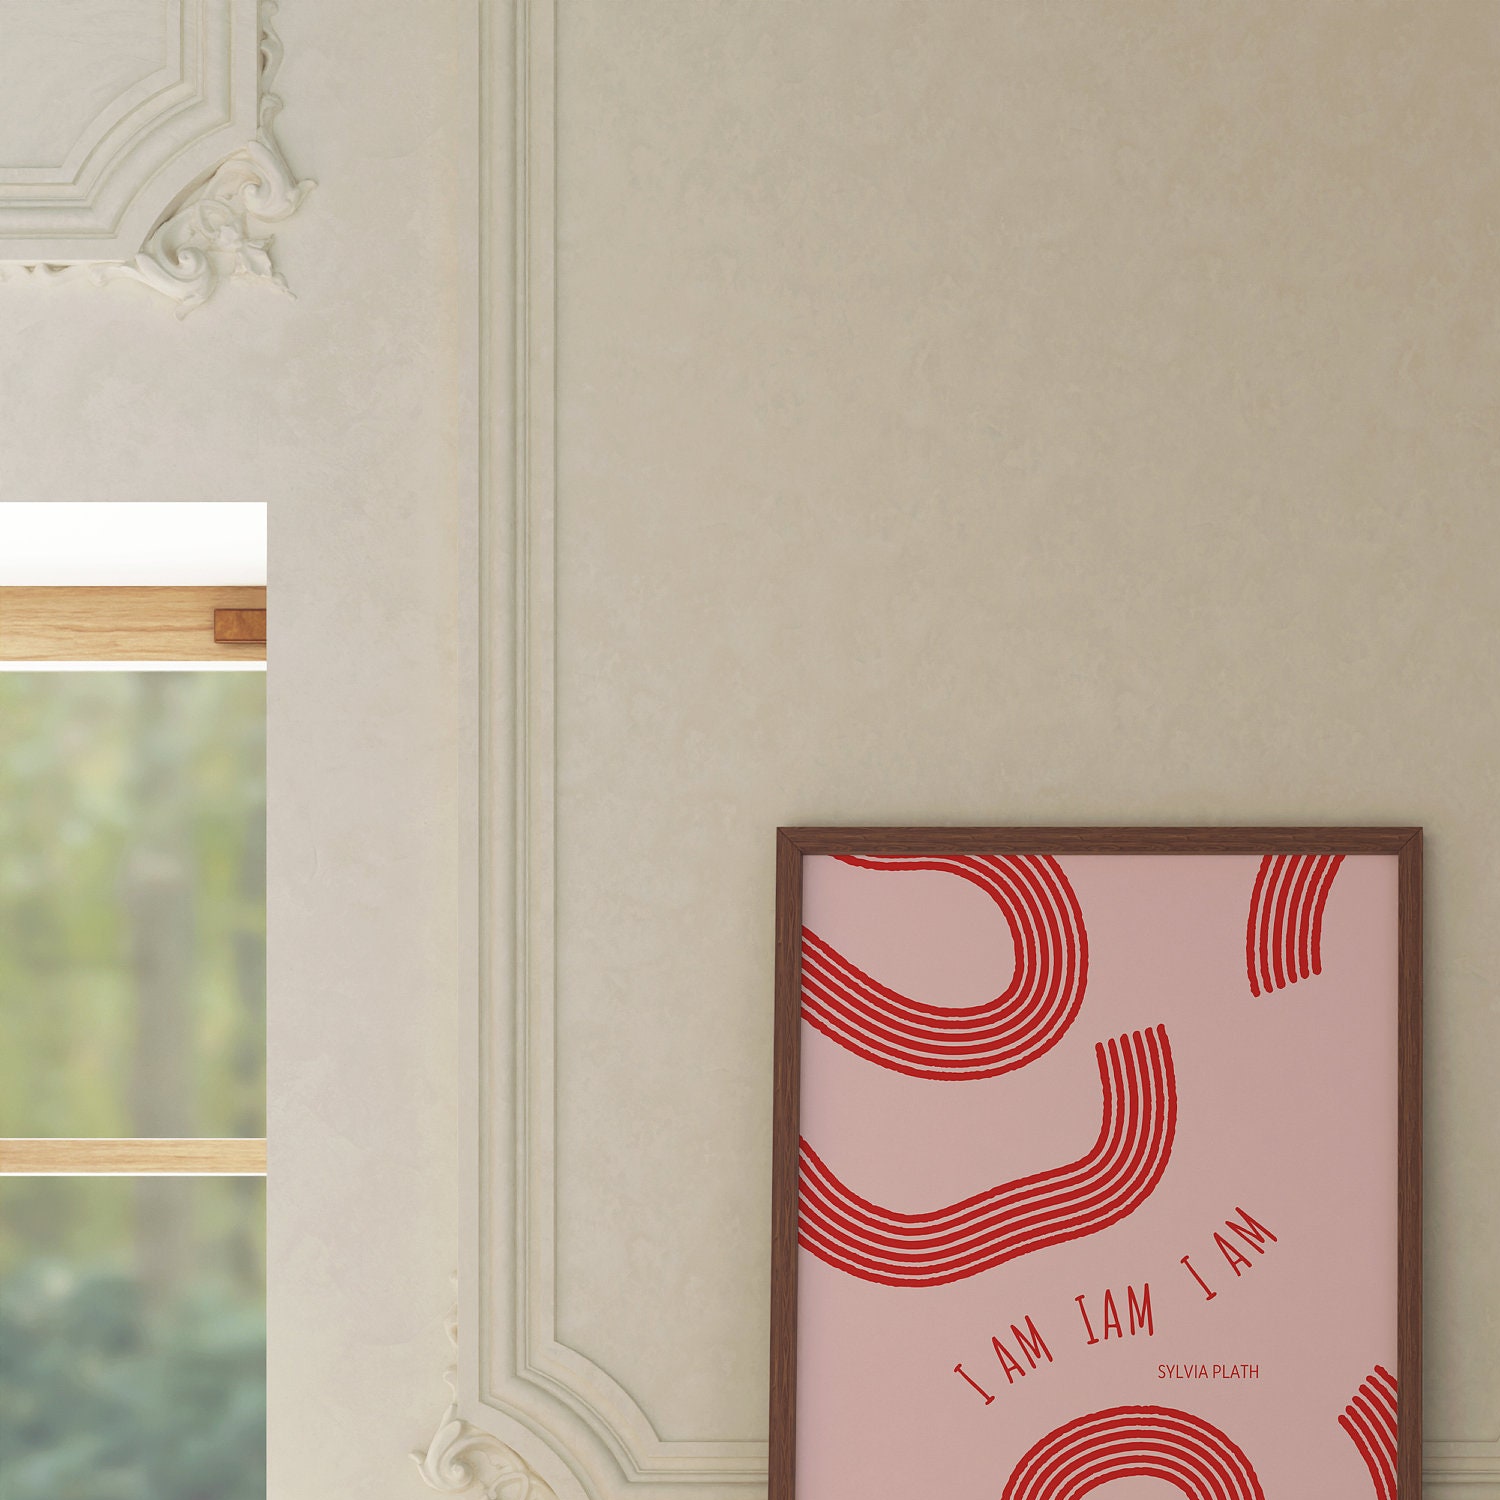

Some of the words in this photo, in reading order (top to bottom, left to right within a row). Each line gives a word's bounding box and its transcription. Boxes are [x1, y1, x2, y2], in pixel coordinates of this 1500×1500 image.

[954, 1363, 995, 1405] I
[991, 1314, 1053, 1384] AM
[1180, 1255, 1217, 1301] I
[1213, 1207, 1277, 1276] AM
[1158, 1364, 1208, 1379] SYLVIA
[1213, 1365, 1260, 1379] PLATH
